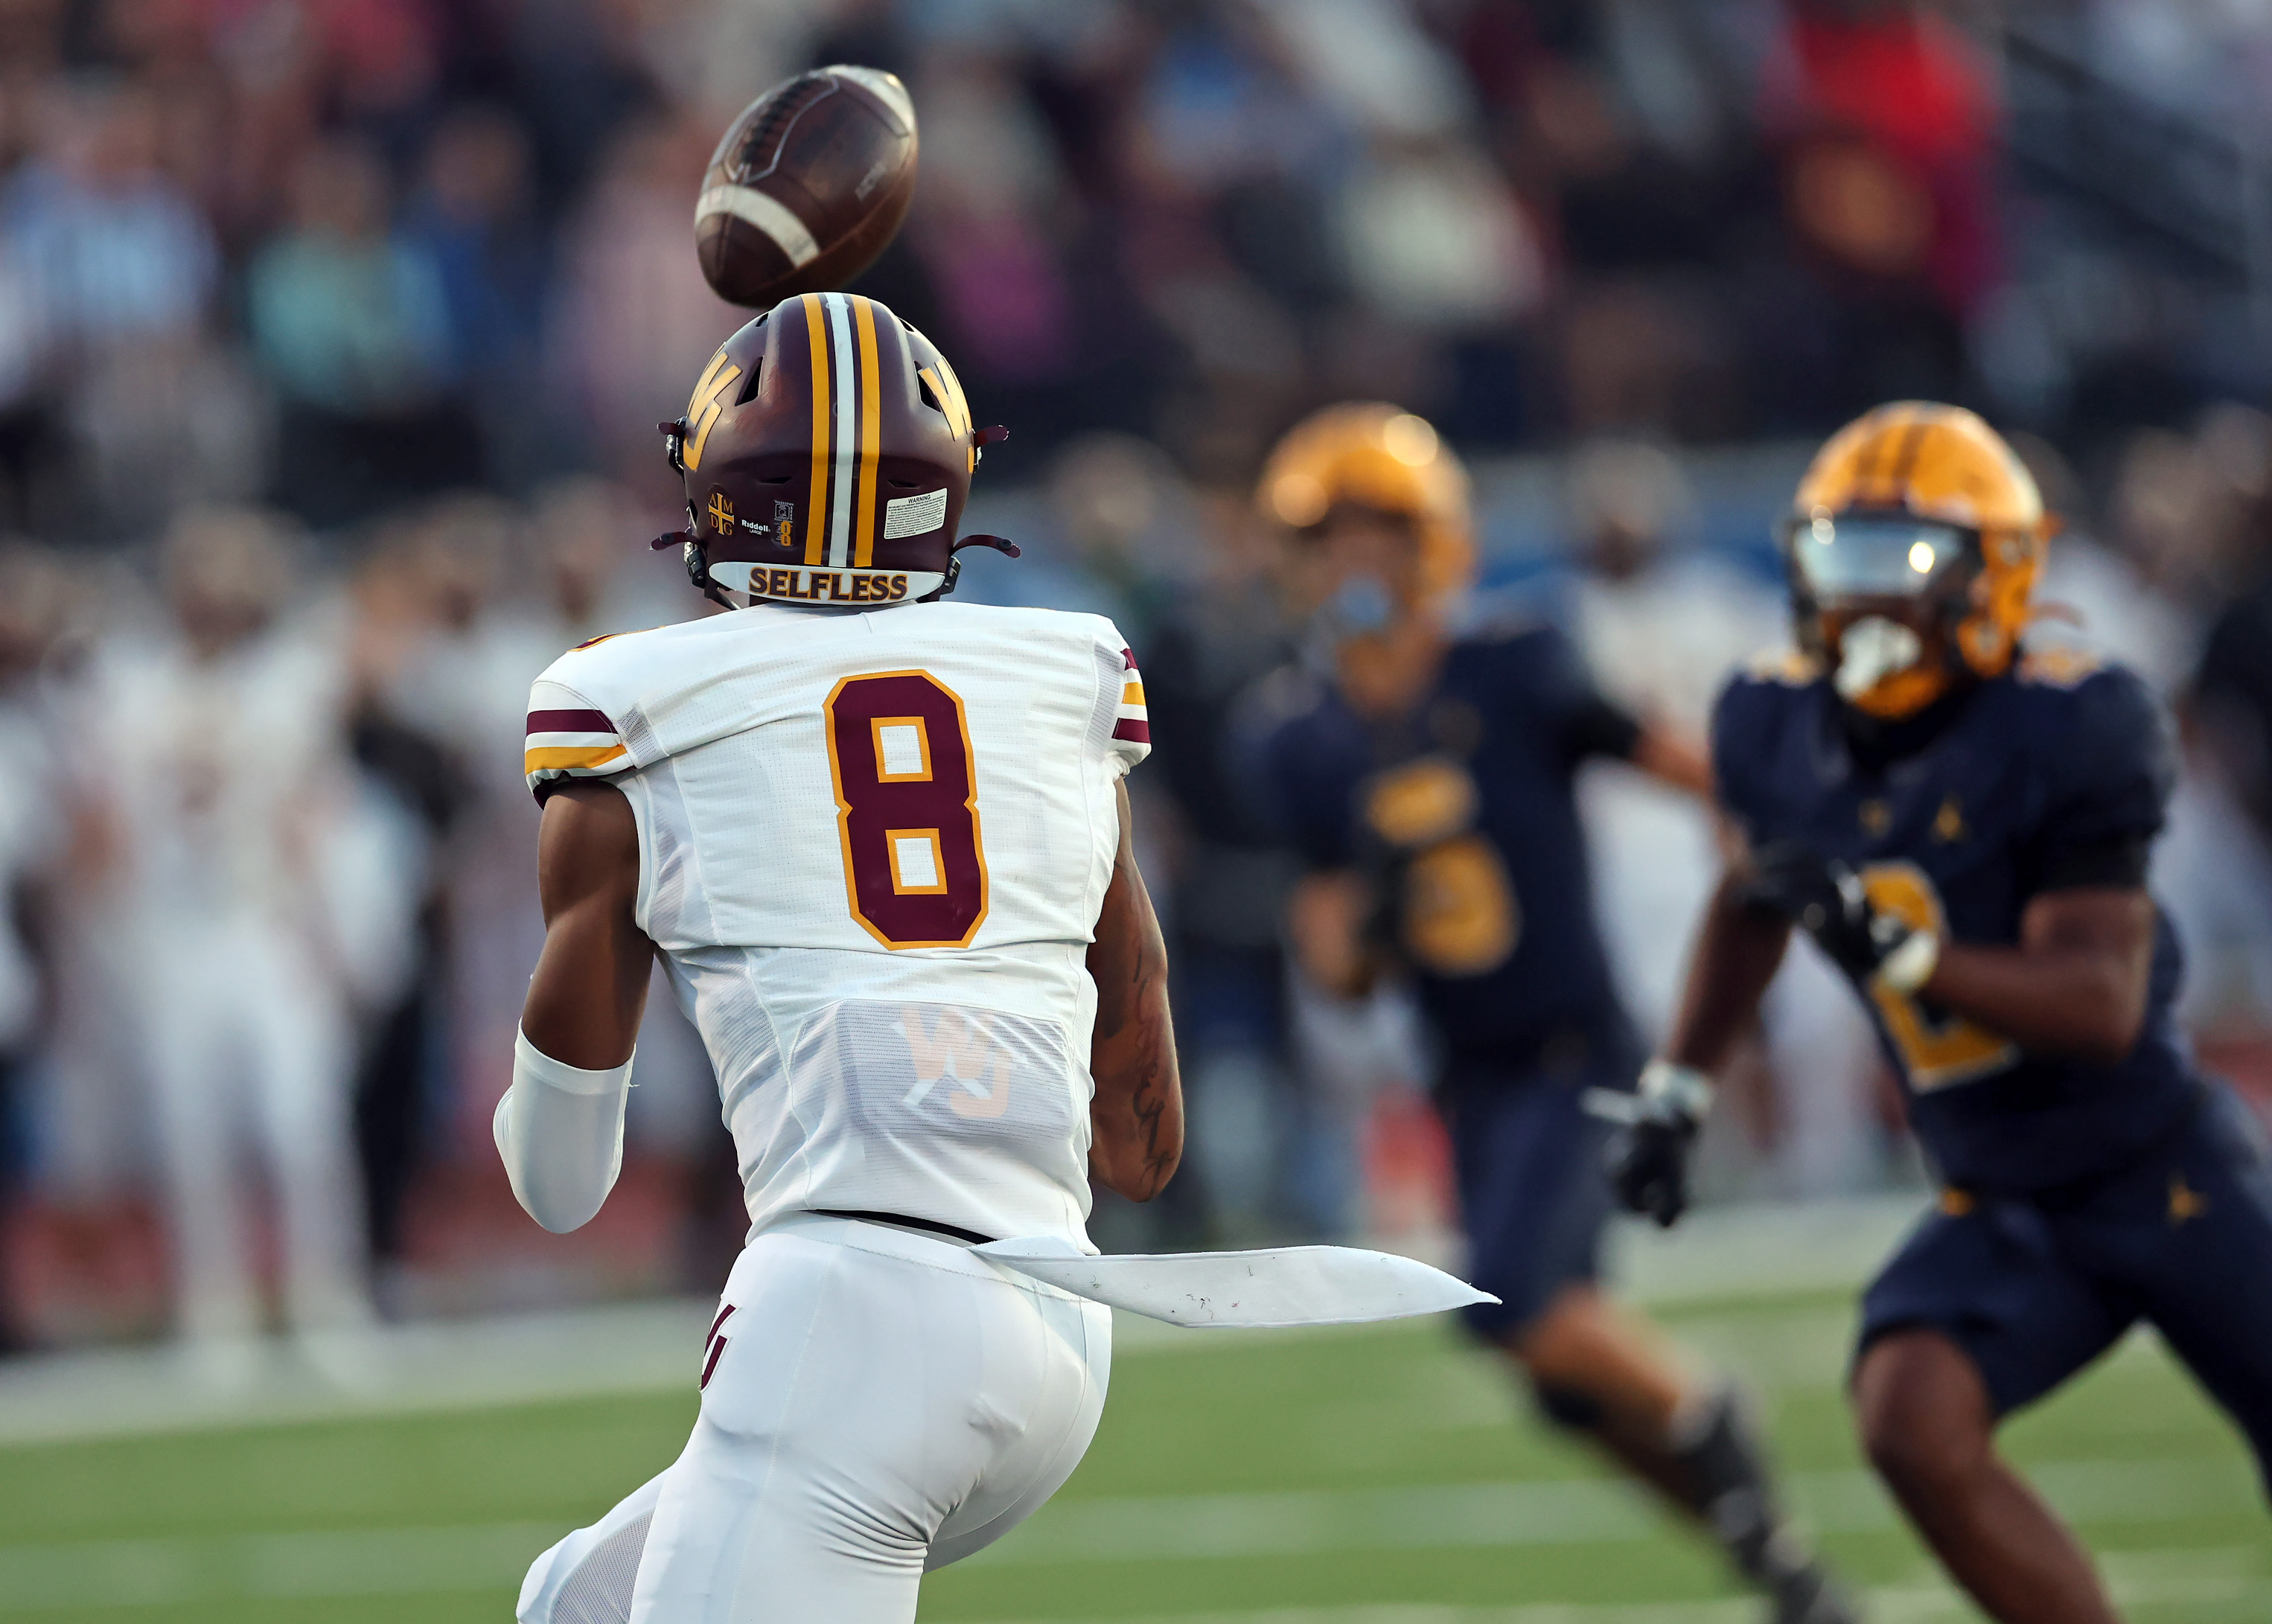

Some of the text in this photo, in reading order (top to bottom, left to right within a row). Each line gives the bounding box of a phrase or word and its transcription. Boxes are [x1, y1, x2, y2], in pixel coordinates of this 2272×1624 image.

[908, 494, 931, 504] WARNING
[741, 519, 768, 532] Riddell
[748, 566, 908, 601] SELFLESS
[823, 668, 989, 950] 8
